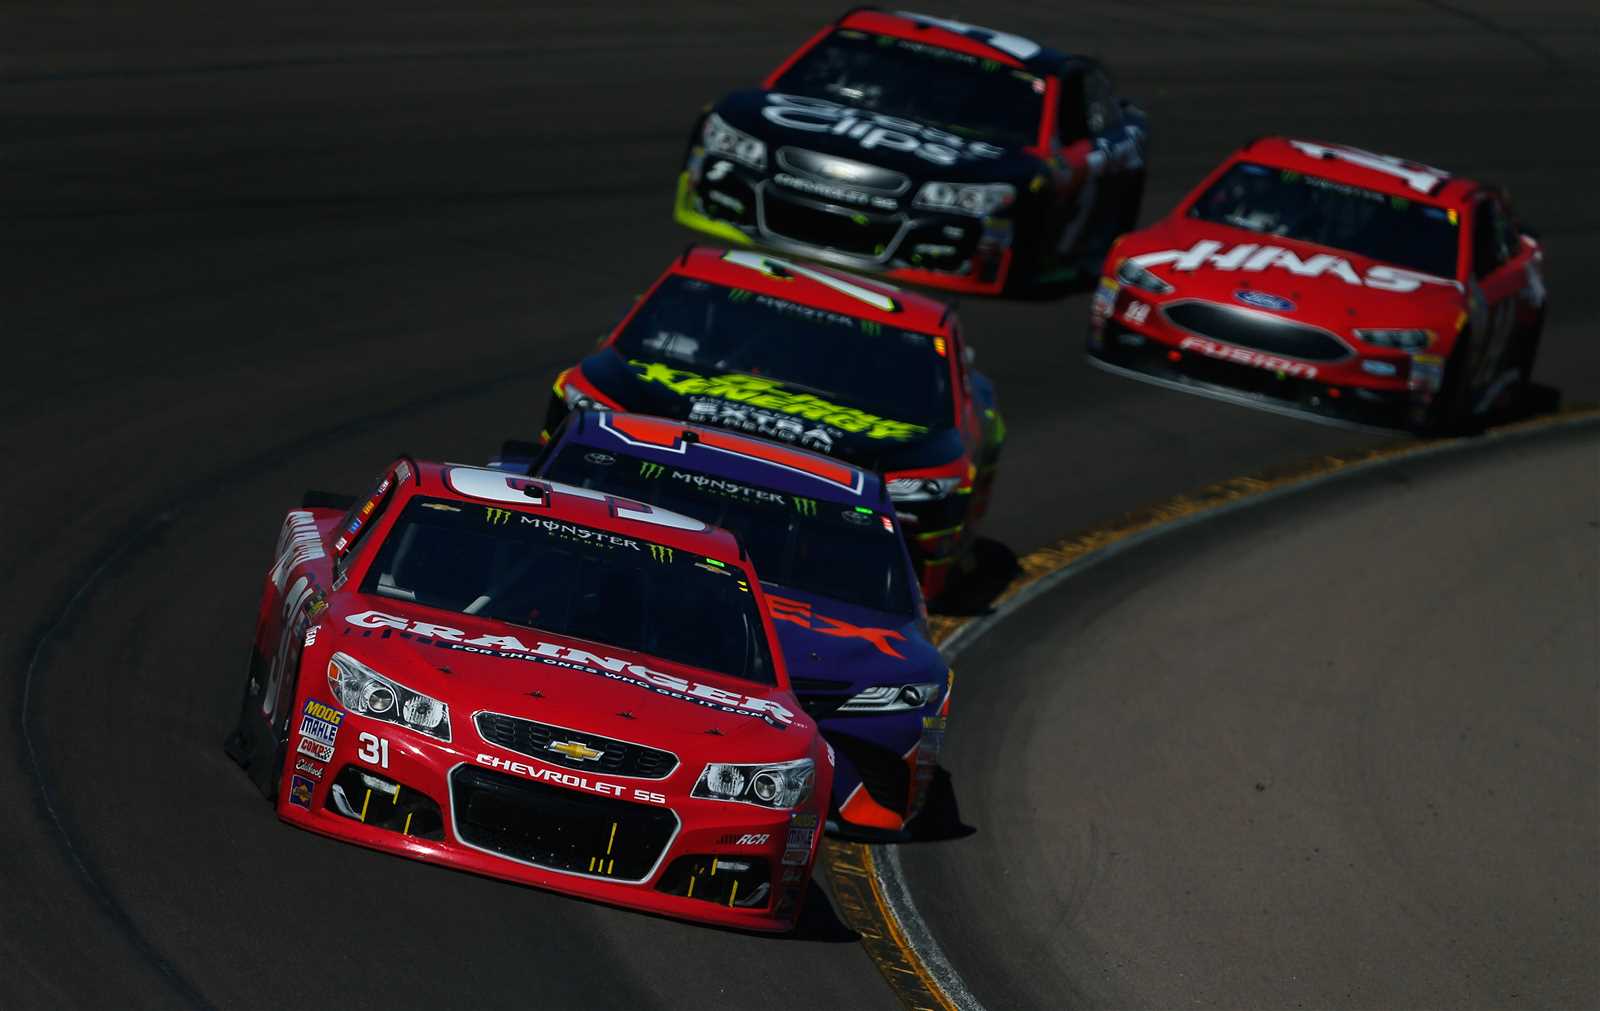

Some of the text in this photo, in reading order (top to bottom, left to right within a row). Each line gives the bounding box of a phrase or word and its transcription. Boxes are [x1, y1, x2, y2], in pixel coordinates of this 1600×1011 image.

[760, 105, 958, 166] Clips
[1168, 239, 1432, 293] HAAS
[671, 470, 787, 506] MONSTER
[520, 515, 641, 552] MONSTER
[345, 610, 795, 726] GRAINGER
[451, 643, 492, 656] FOR
[498, 649, 538, 662] THE
[542, 657, 599, 675] ONES
[604, 671, 651, 689] WHO
[655, 687, 693, 702] GET
[300, 715, 337, 743] MAHLE
[304, 700, 344, 726] MOOG
[358, 731, 390, 769] 31
[475, 753, 666, 804] CHEVROLET SS
[735, 833, 771, 847] RCR
